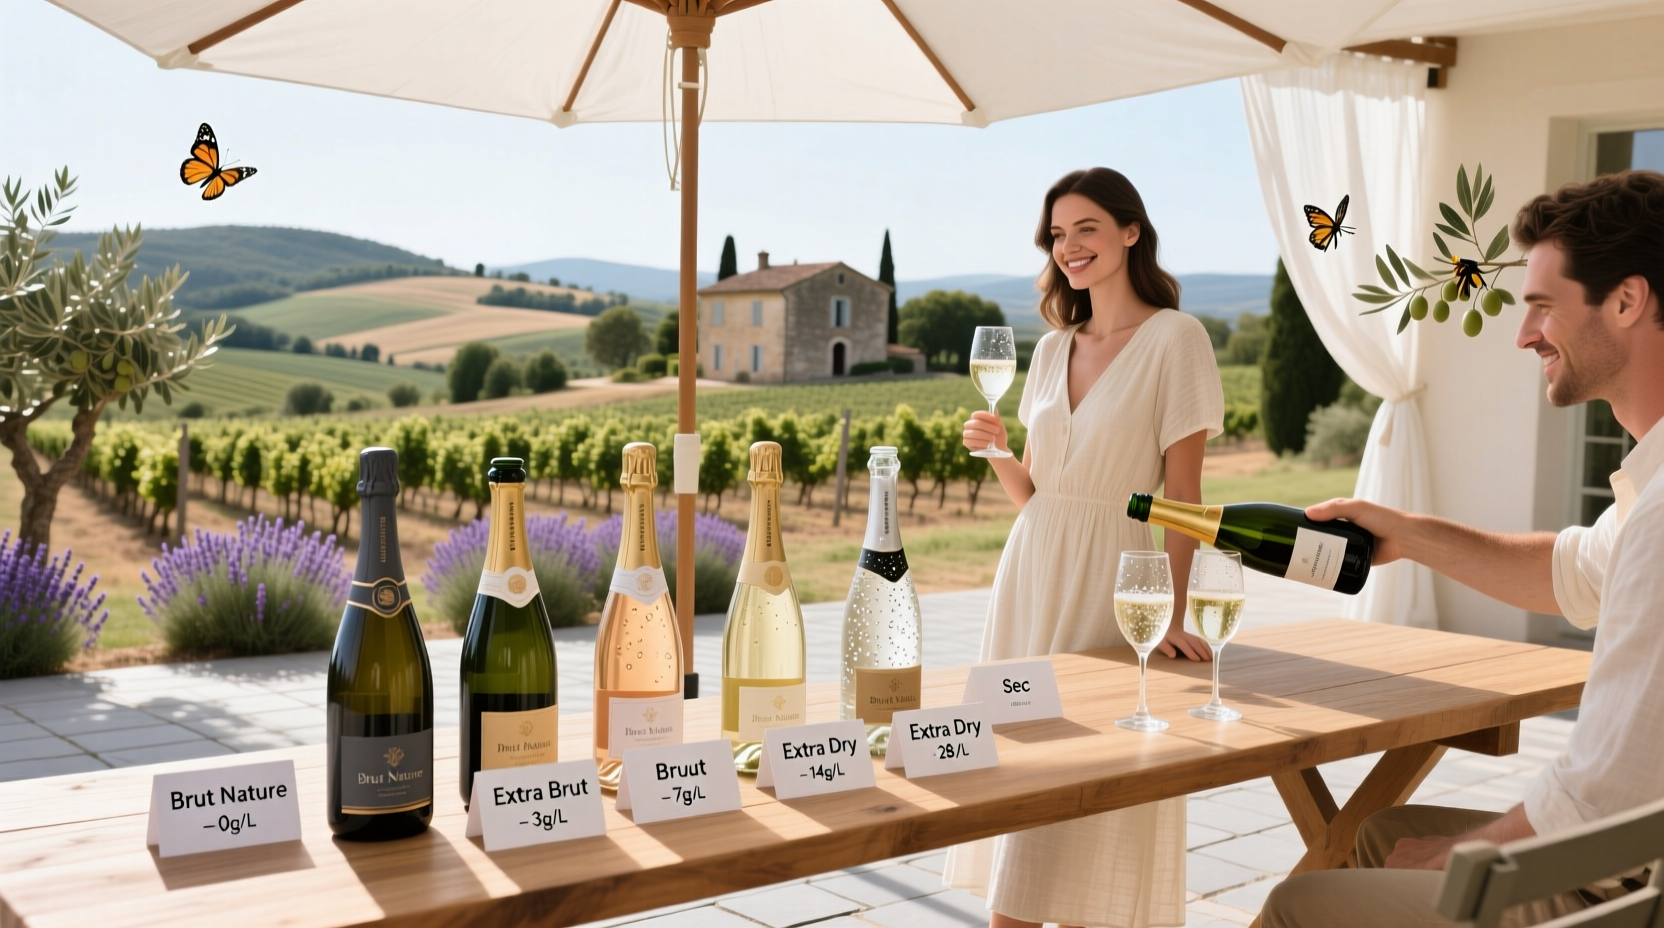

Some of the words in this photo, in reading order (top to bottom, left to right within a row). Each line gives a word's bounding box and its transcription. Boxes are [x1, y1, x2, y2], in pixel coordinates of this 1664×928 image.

[1002, 678, 1031, 694] Sec
[909, 723, 951, 741] Extra
[953, 718, 981, 738] Dry
[782, 742, 826, 760] Extra
[828, 737, 857, 757] Dry
[655, 758, 707, 781] Bruut
[170, 789, 216, 811] Brut
[220, 784, 288, 805] Nature
[493, 786, 544, 806] Extra
[548, 778, 589, 799] Brut
